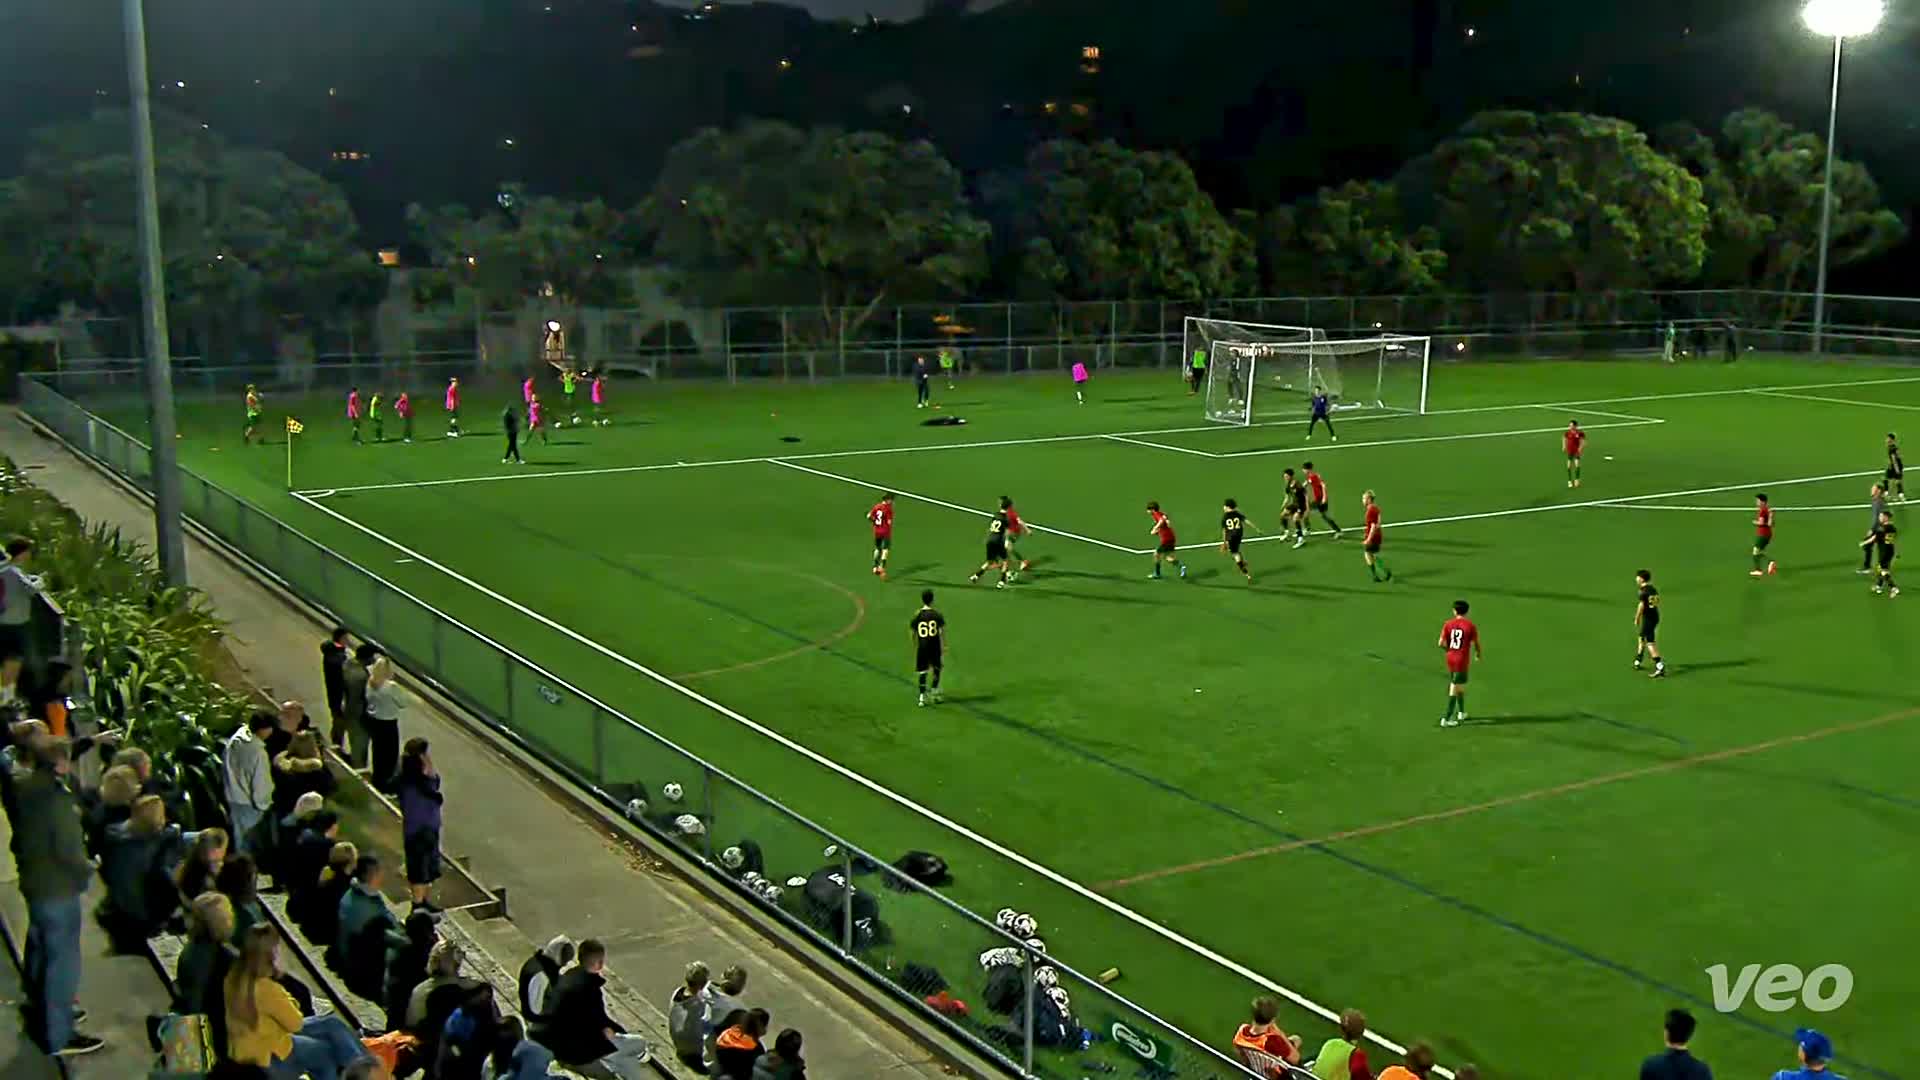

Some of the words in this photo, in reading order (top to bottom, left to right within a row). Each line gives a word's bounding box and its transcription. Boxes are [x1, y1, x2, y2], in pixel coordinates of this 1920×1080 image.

[875, 510, 883, 525] 3
[1225, 517, 1240, 530] 92
[917, 620, 938, 638] 68
[1449, 629, 1463, 649] 13
